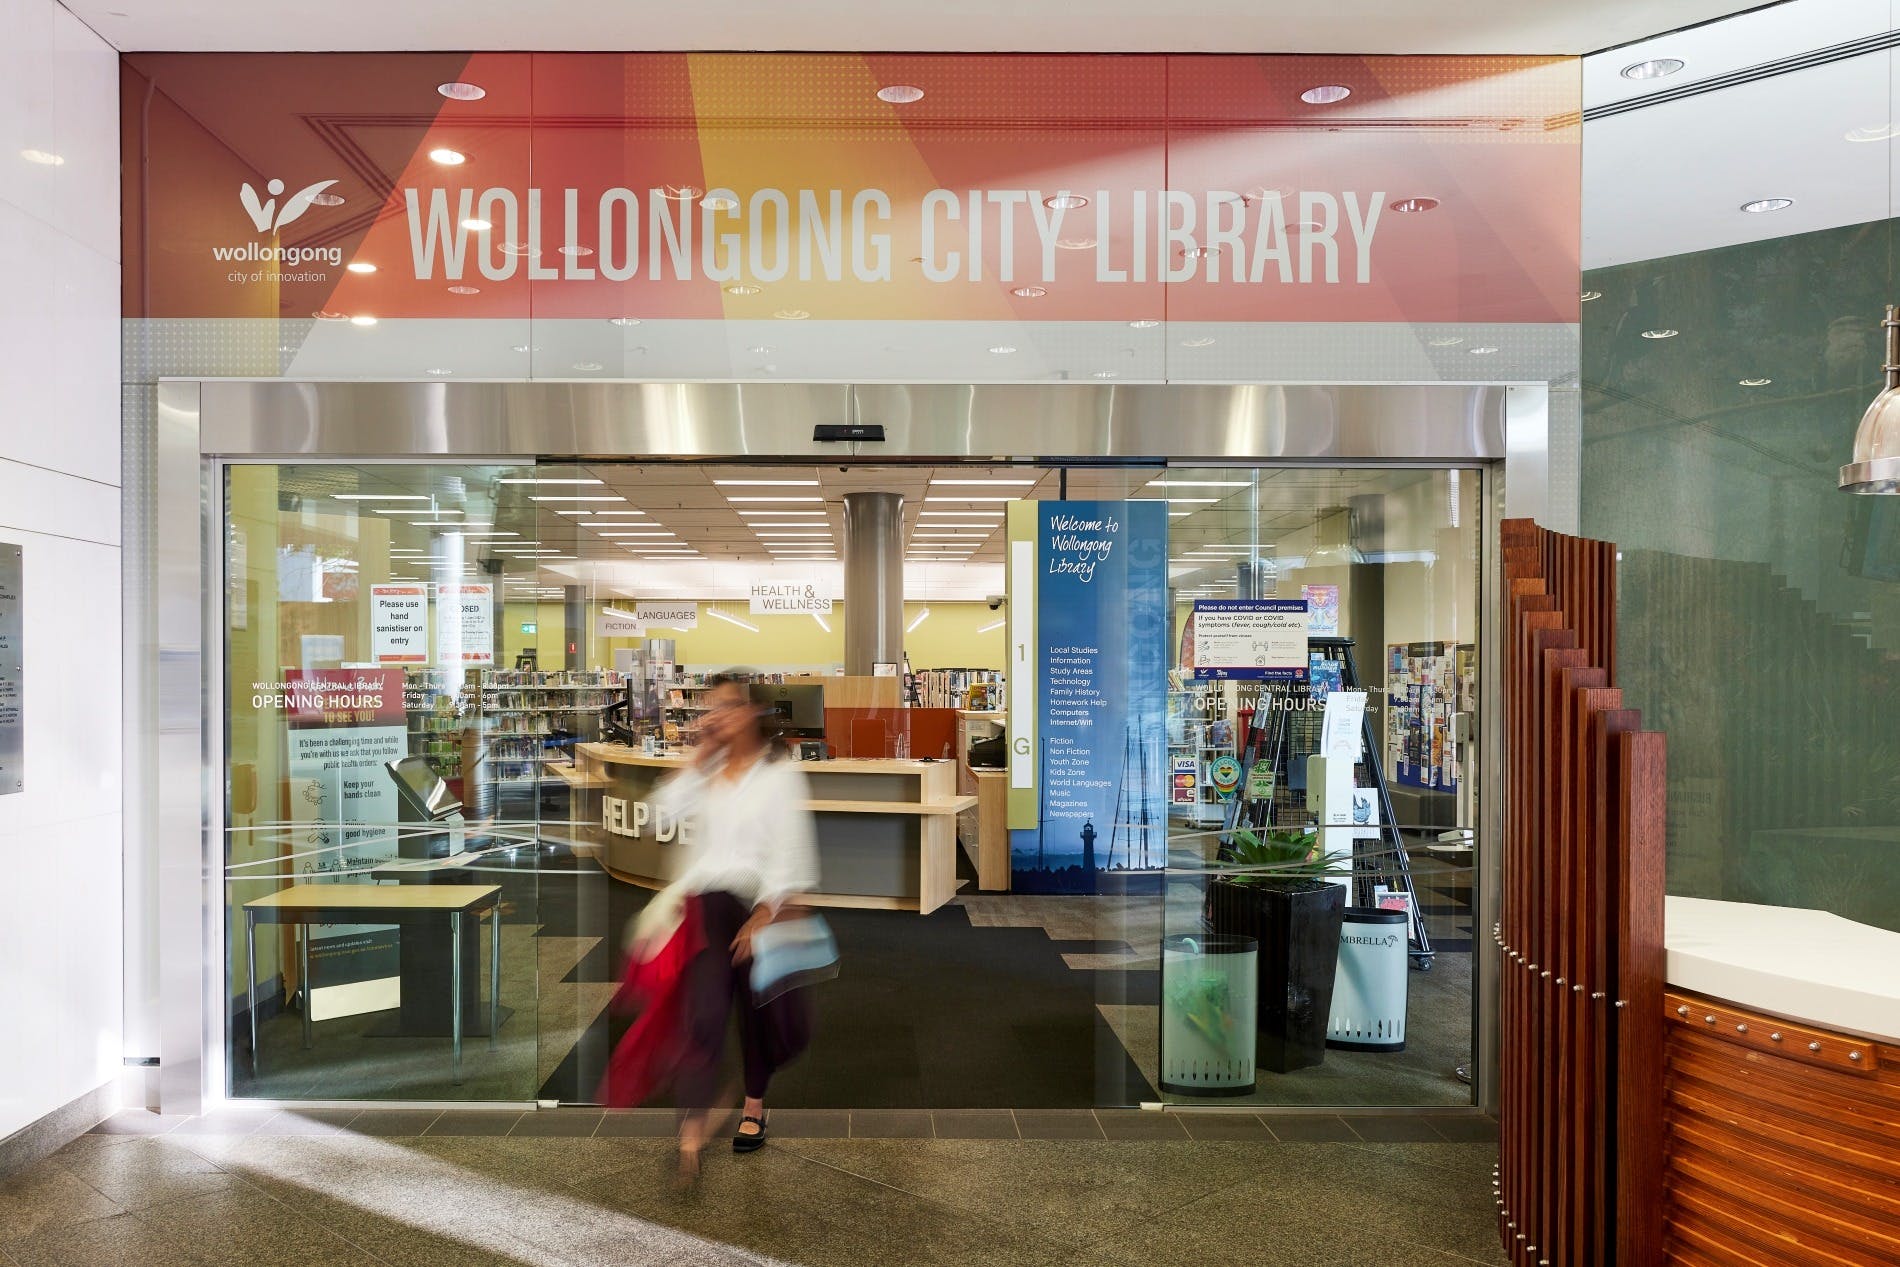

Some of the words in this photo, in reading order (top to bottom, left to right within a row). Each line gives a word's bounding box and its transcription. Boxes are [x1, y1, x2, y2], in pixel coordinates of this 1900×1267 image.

[405, 186, 891, 282] WOLLONGONG
[920, 188, 1071, 282] CITY
[1096, 190, 1386, 283] LIBRARY
[213, 242, 342, 266] wollongong
[228, 270, 247, 284] city
[251, 270, 264, 282] of
[266, 271, 326, 282] innovation
[1050, 515, 1102, 532] Welcome
[1105, 516, 1119, 533] to
[1051, 535, 1112, 561] Wollongong
[1049, 558, 1096, 583] Library
[751, 585, 801, 596] HEALTH
[804, 584, 815, 598] &
[763, 599, 830, 610] WELLNESS
[1278, 605, 1304, 613] premises
[637, 611, 696, 620] LANGUAGES
[376, 624, 412, 632] sanistiser
[390, 636, 409, 646] entry
[1018, 644, 1024, 662] 1
[1050, 668, 1070, 676] Study
[252, 682, 308, 690] WOLLONGONG
[311, 682, 347, 690] CENTRAL
[1050, 678, 1090, 687] Technology
[1050, 688, 1073, 697] Family
[1075, 688, 1100, 697] History
[1195, 684, 1252, 692] WOLLOONG
[1255, 684, 1291, 692] CENTRAL
[252, 695, 324, 708] OPENING
[329, 695, 384, 708] HOURS
[402, 692, 424, 702] Friday
[402, 702, 434, 710] Saturday
[1090, 699, 1108, 708] Help
[1195, 698, 1268, 711] OPEING
[1272, 698, 1327, 712] HOURS
[324, 712, 335, 722] TO
[337, 711, 352, 722] SEE
[354, 710, 375, 722] YOU!
[1050, 709, 1089, 717] Computers
[310, 739, 324, 747] been
[330, 738, 360, 748] challenging
[361, 737, 372, 745] time
[1014, 737, 1030, 756] G
[300, 750, 318, 760] you're
[320, 750, 332, 758] with
[372, 749, 382, 757] you
[324, 760, 340, 771] public
[344, 781, 360, 790] Keep
[360, 780, 374, 790] your
[1072, 779, 1112, 788] Languages
[344, 792, 362, 800] hands
[1050, 800, 1088, 808] Magazines
[1050, 810, 1094, 818] Newspapers
[602, 796, 650, 838] HELP
[656, 804, 698, 845] DE
[345, 830, 360, 840] good
[362, 828, 386, 838] hygiene
[346, 858, 374, 866] Maintain
[1340, 935, 1388, 946] MBRELLA
